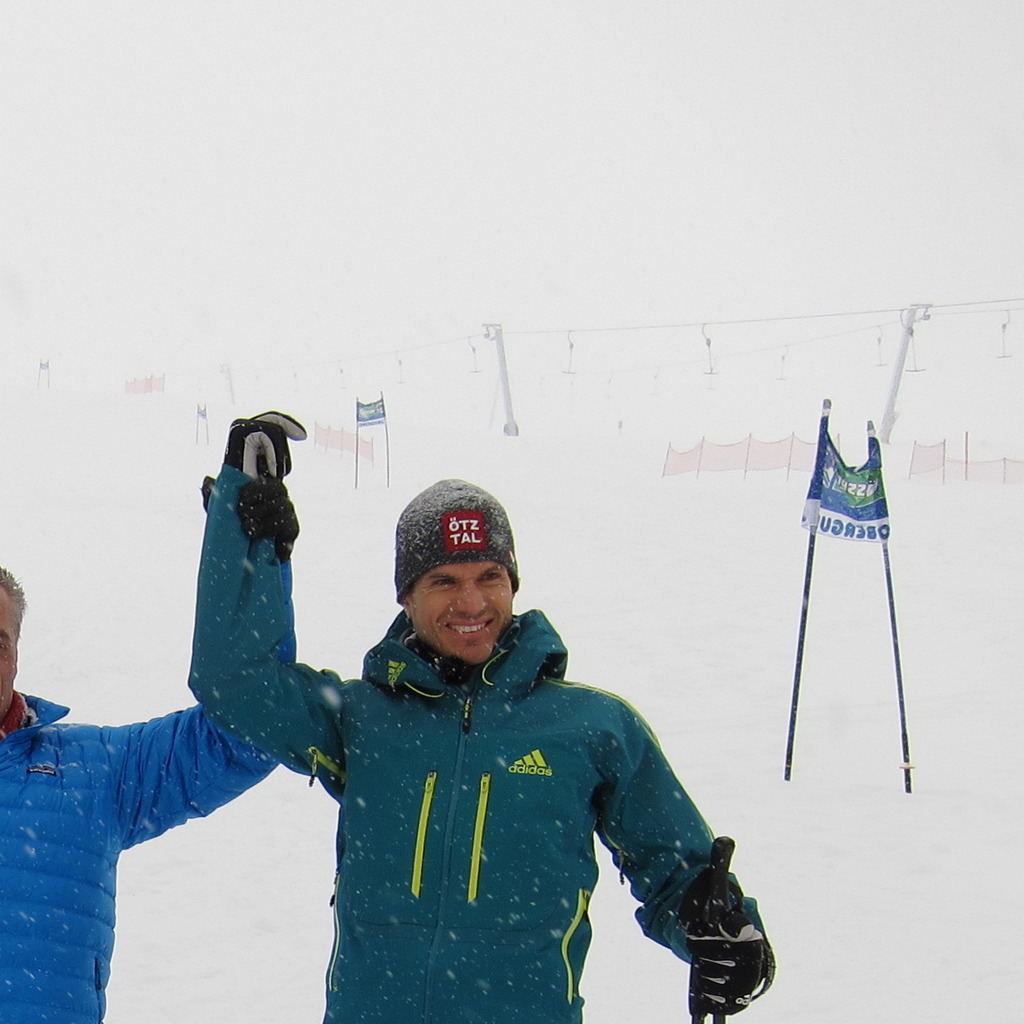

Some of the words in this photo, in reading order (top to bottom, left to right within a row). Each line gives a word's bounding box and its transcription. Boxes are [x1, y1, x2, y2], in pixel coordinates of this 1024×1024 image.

[448, 516, 480, 532] ÖTZ
[449, 532, 483, 546] TAL
[508, 764, 553, 777] adidas
